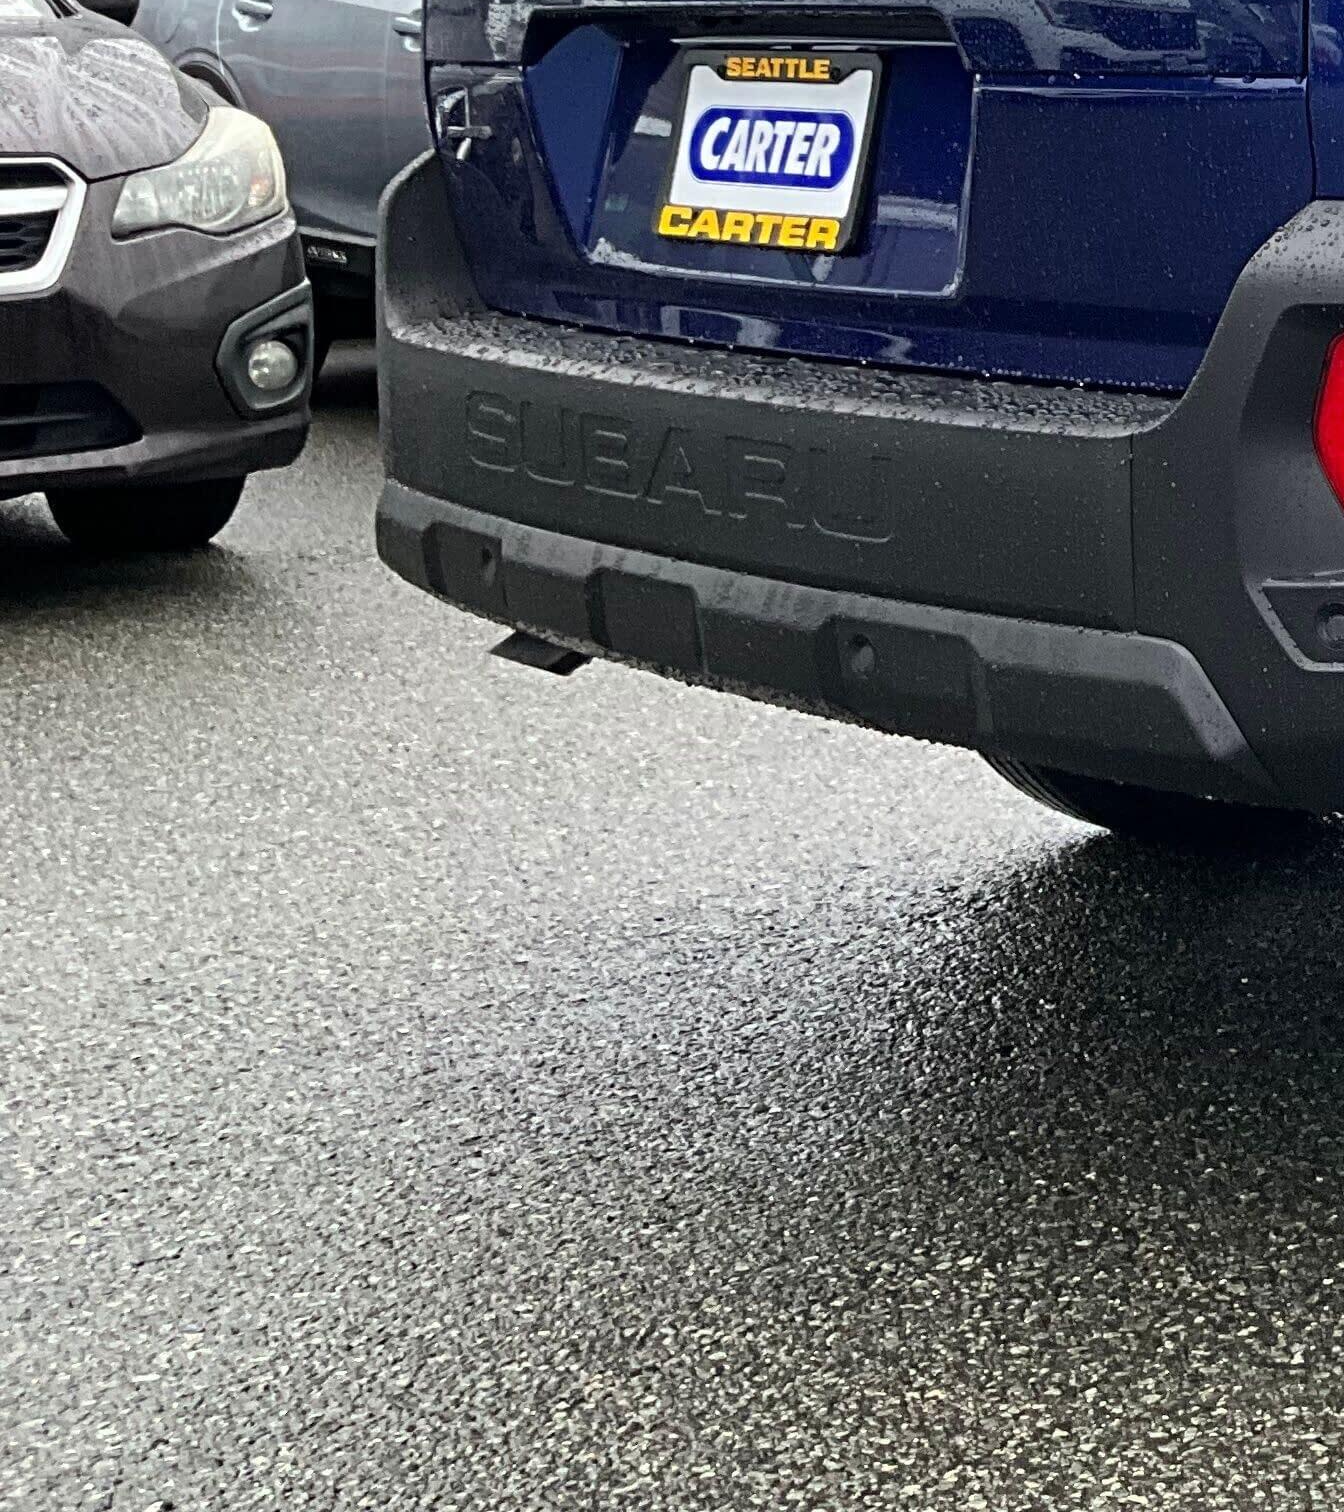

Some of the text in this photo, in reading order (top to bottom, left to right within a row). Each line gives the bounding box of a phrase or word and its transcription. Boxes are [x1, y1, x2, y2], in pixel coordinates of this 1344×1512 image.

[726, 56, 831, 80] SEATTLE
[700, 116, 841, 178] CARTER
[658, 204, 841, 250] CARTER
[464, 389, 894, 545] SUBARU
